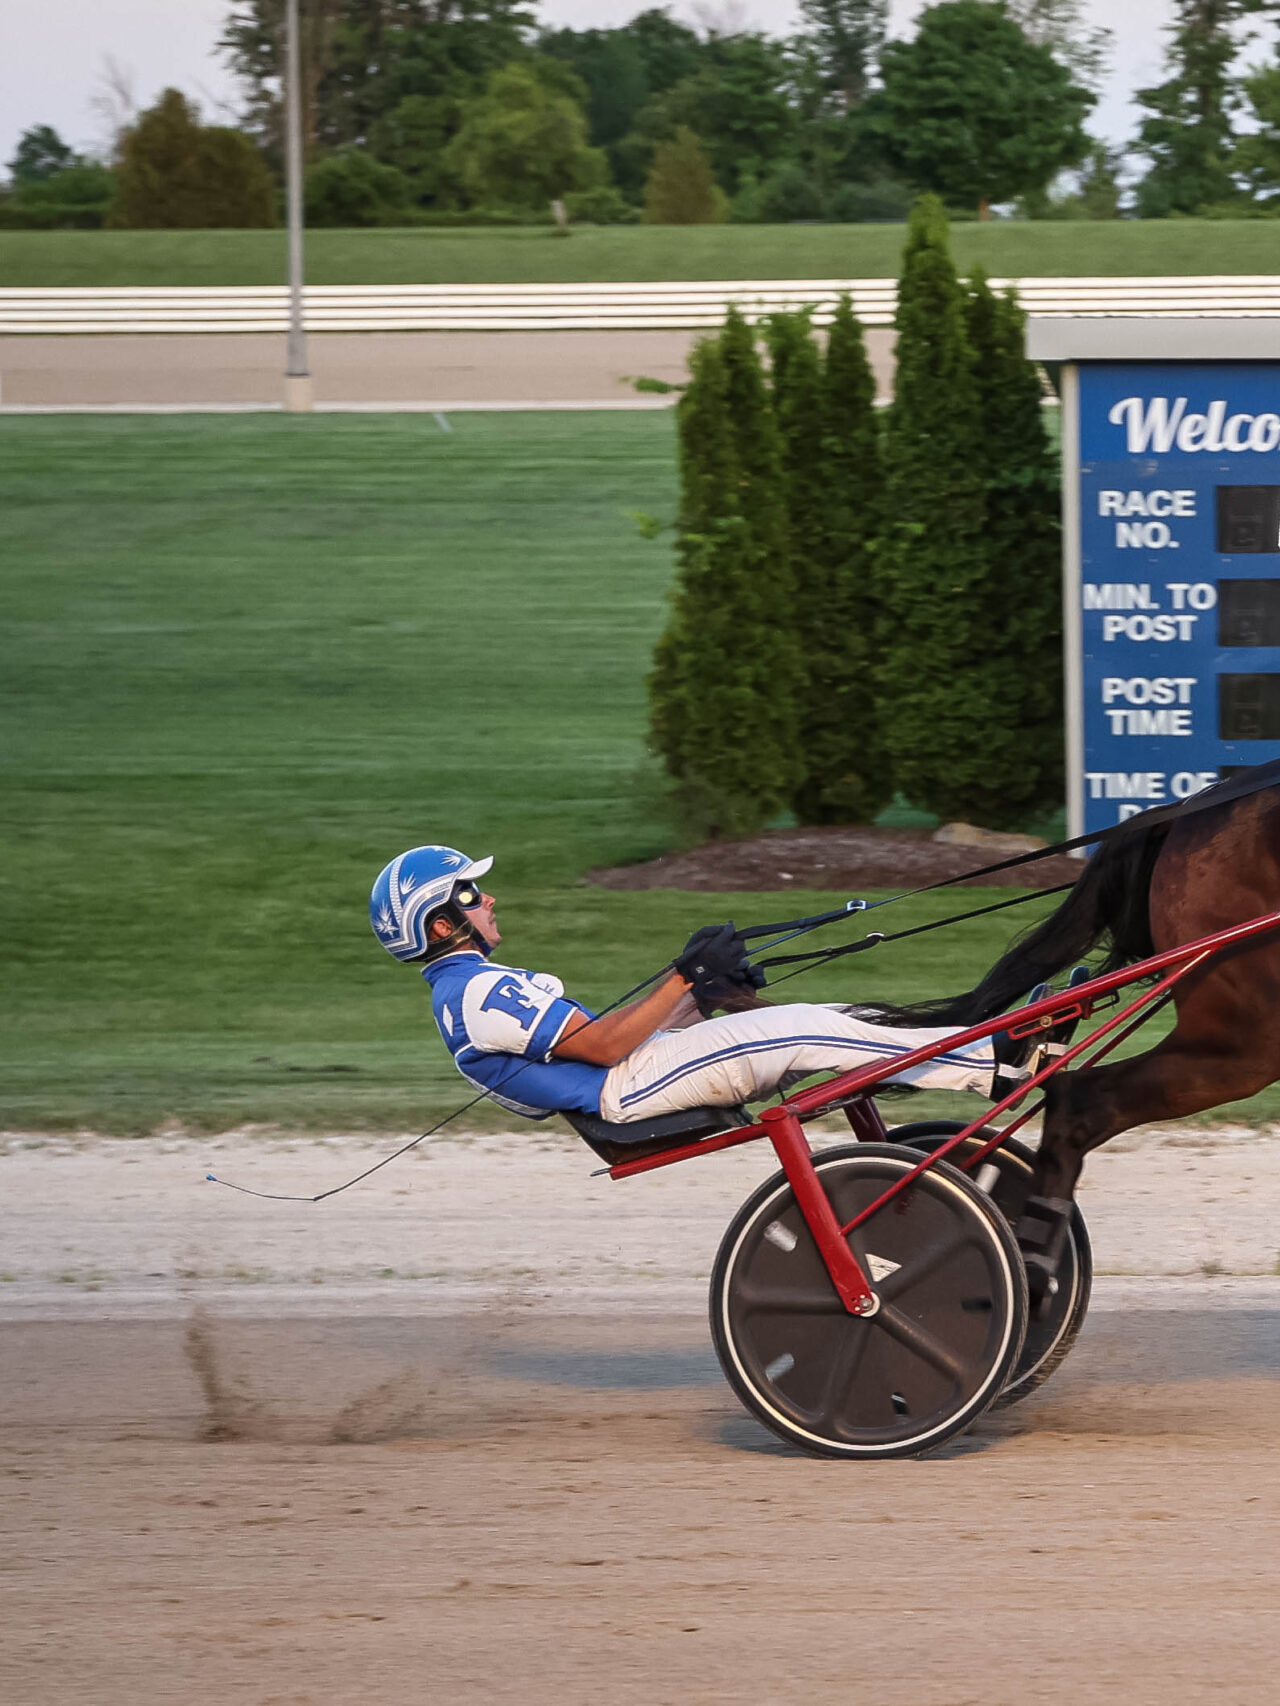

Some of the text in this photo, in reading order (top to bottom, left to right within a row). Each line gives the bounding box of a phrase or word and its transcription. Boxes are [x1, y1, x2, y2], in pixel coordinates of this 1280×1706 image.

[1098, 489, 1196, 517] RACE
[1115, 521, 1179, 549] NO.
[1083, 582, 1218, 610] MIN. TO
[1102, 614, 1198, 642] POST
[1101, 677, 1197, 705] POST
[1105, 709, 1193, 736] TIME
[1085, 772, 1166, 798] TIME
[479, 974, 541, 1032] F
